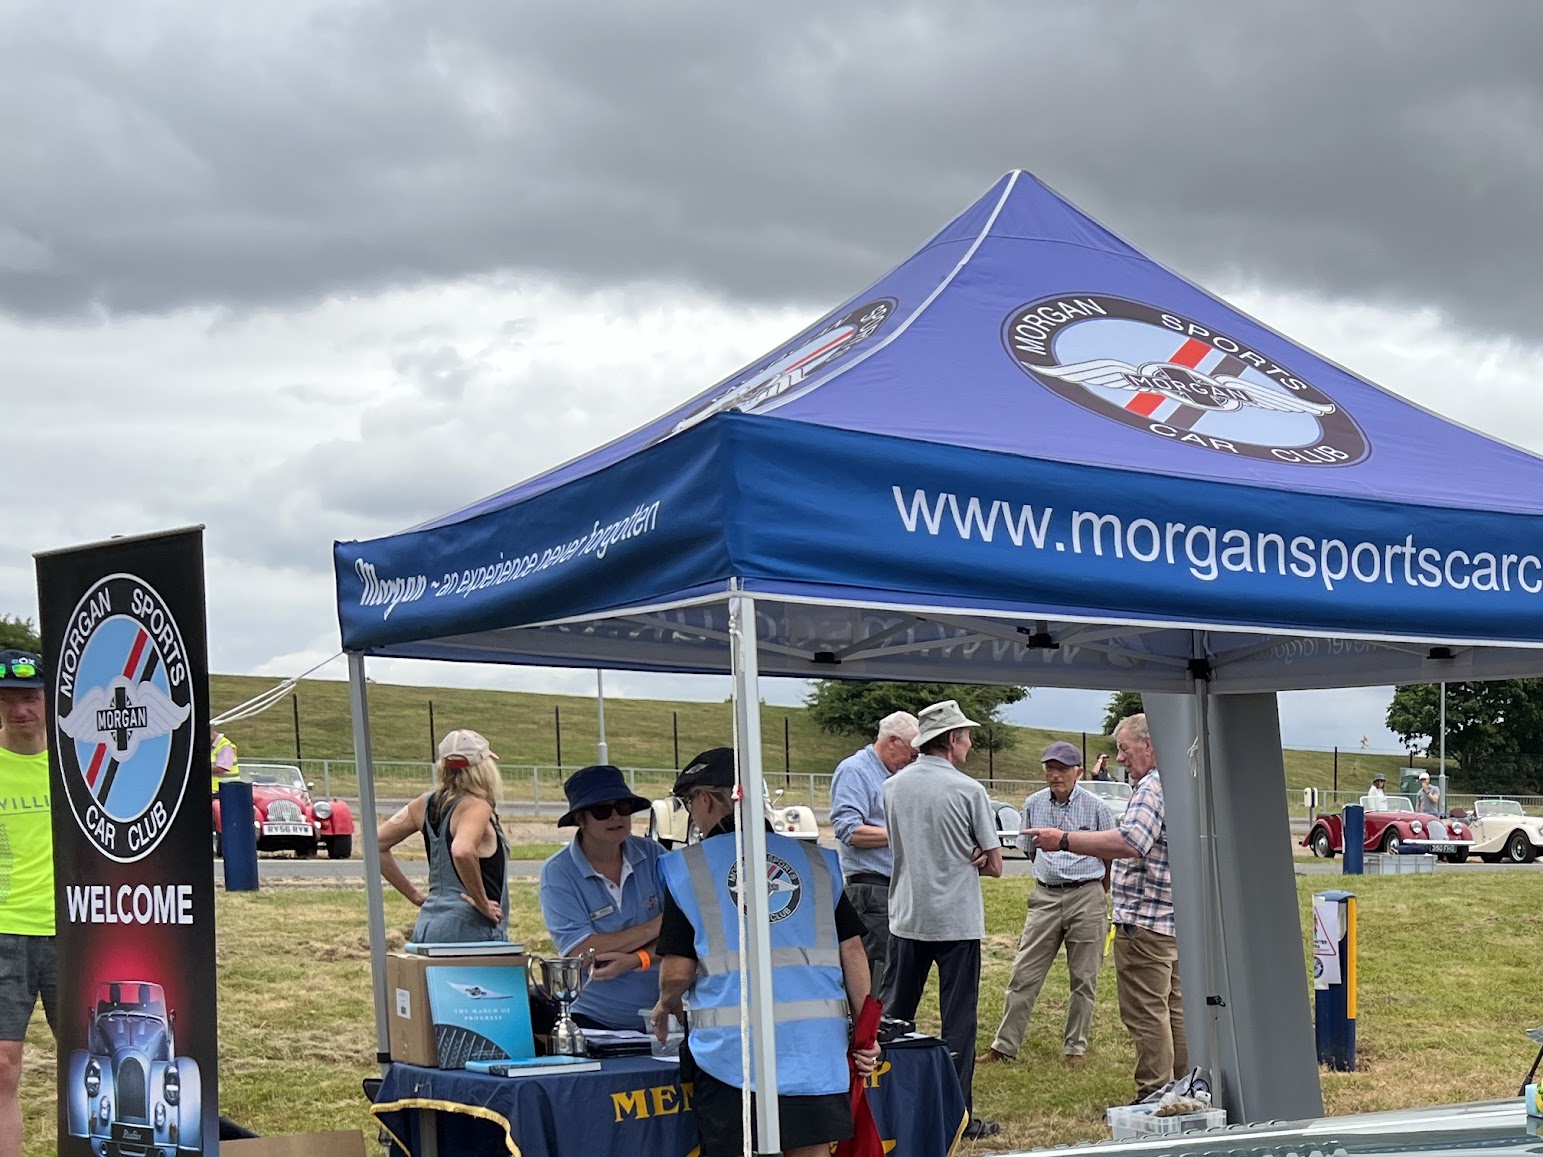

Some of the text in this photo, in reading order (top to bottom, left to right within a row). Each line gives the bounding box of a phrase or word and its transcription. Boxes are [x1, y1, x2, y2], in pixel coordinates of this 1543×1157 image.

[1015, 298, 1308, 391] MORGAN SPORTS
[1128, 374, 1247, 401] MORGAN
[1149, 423, 1350, 464] CAR CLUB
[355, 557, 428, 621] Morgan
[456, 552, 538, 598] experience
[535, 536, 587, 572] never
[582, 500, 661, 559] forgotten
[59, 587, 185, 698] MORGAN SPORTS
[97, 708, 147, 730] MORGAN
[86, 801, 167, 851] CAR CLUB
[66, 884, 194, 925] WELCOME
[769, 908, 791, 921] CLUB
